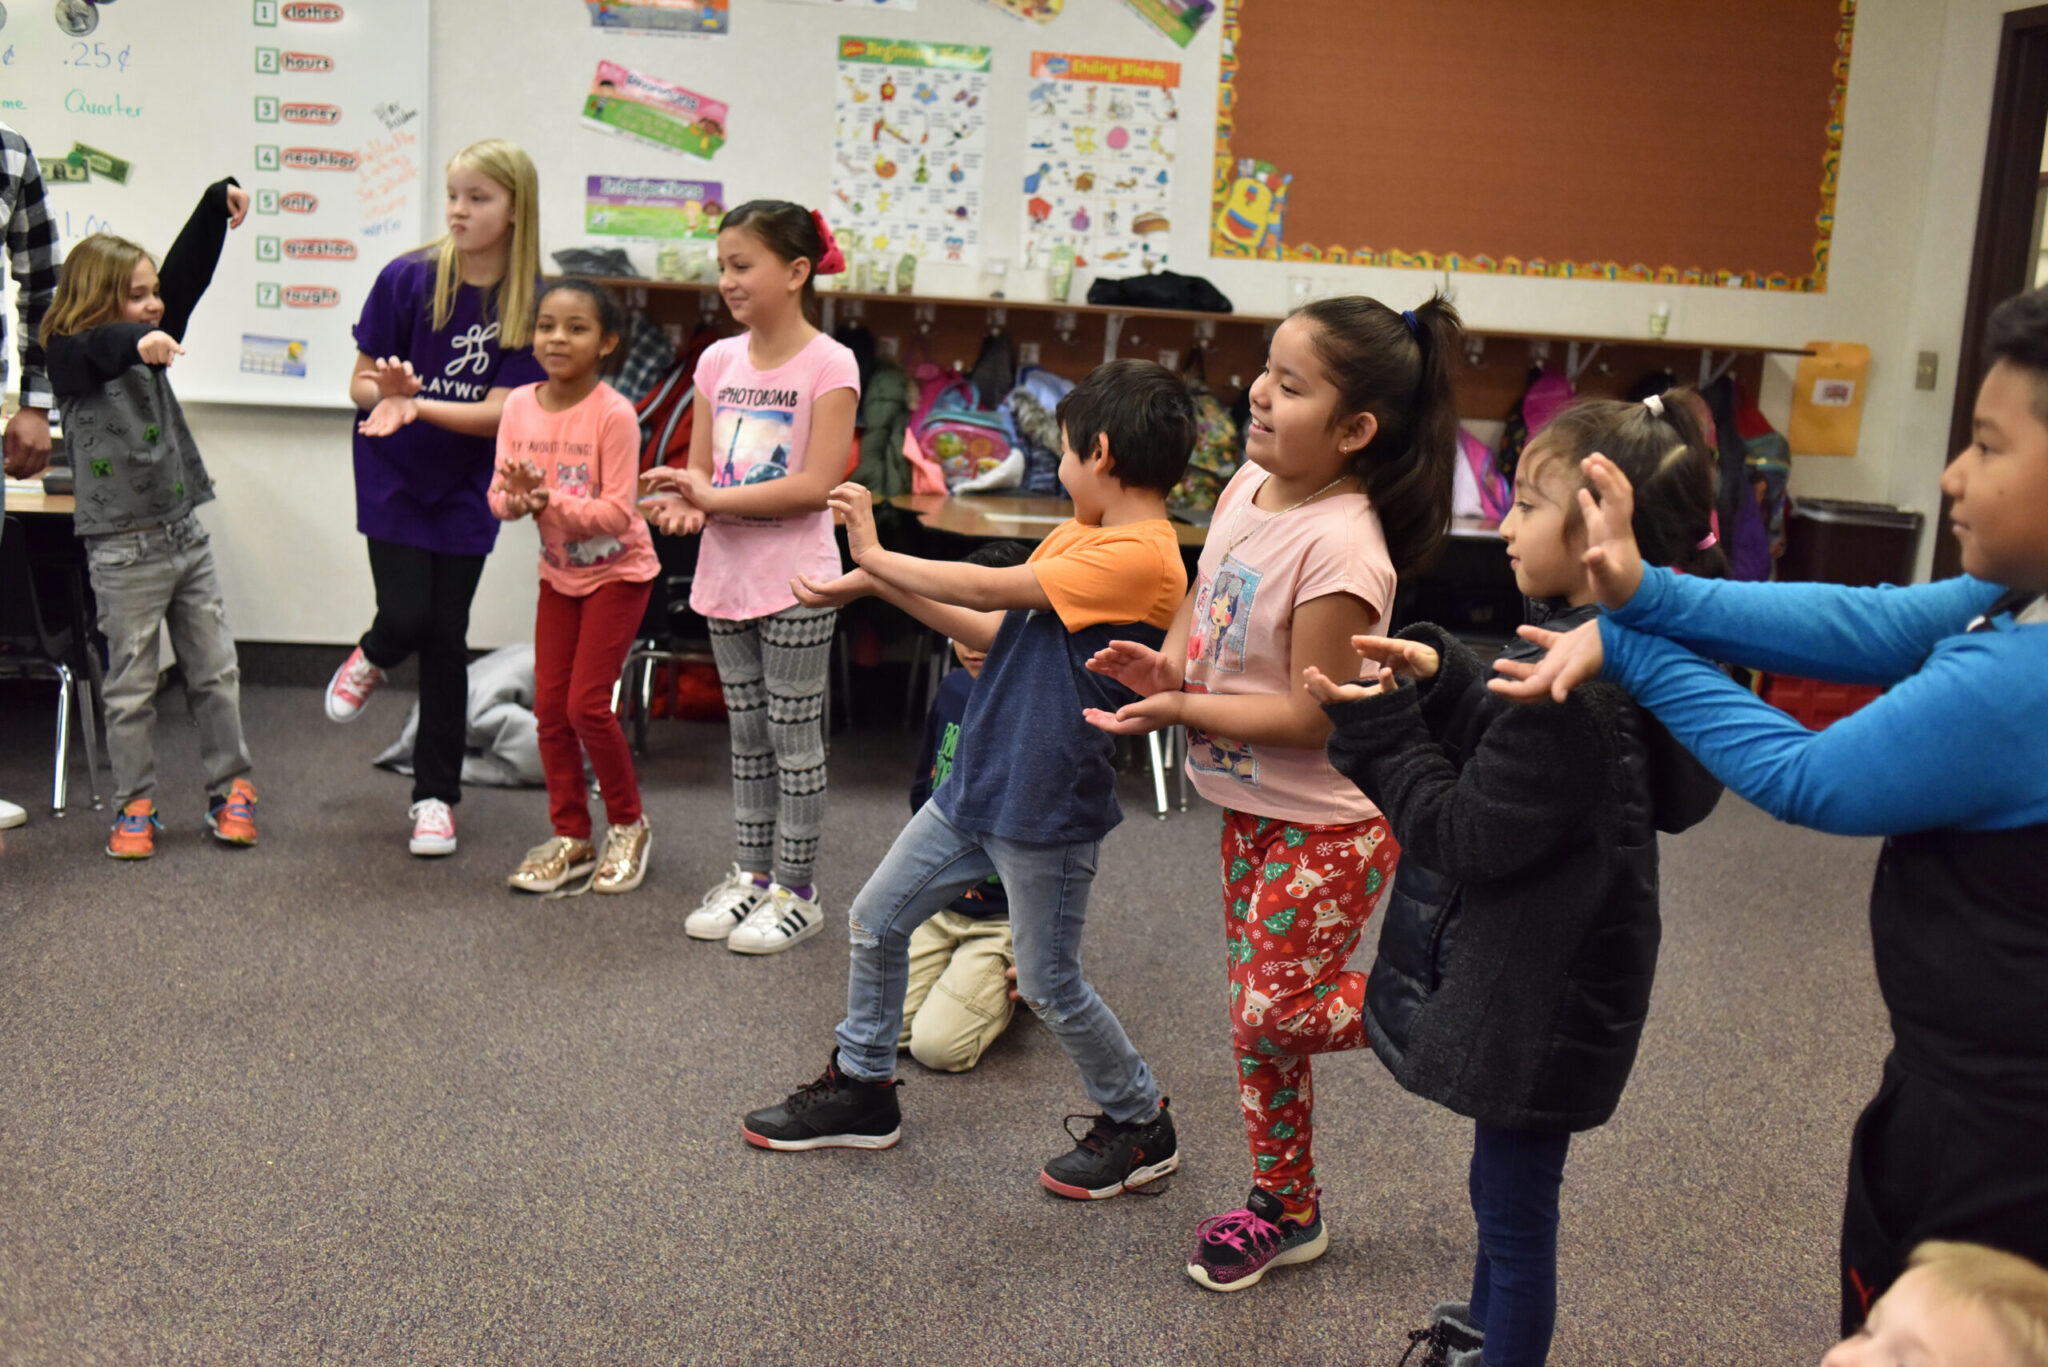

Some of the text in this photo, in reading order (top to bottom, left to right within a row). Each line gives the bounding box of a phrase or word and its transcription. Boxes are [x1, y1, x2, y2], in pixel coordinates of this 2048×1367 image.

[284, 6, 340, 19] clothes
[285, 55, 330, 69] hours
[1072, 59, 1167, 81] Ending Blends
[65, 88, 143, 117] Quarter
[284, 106, 338, 121] money
[284, 152, 356, 167] neighbor
[601, 177, 705, 200] Interjections
[281, 193, 316, 212] only
[286, 242, 354, 255] question
[285, 289, 337, 303] taught
[718, 387, 798, 407] #PHOTOBOMB
